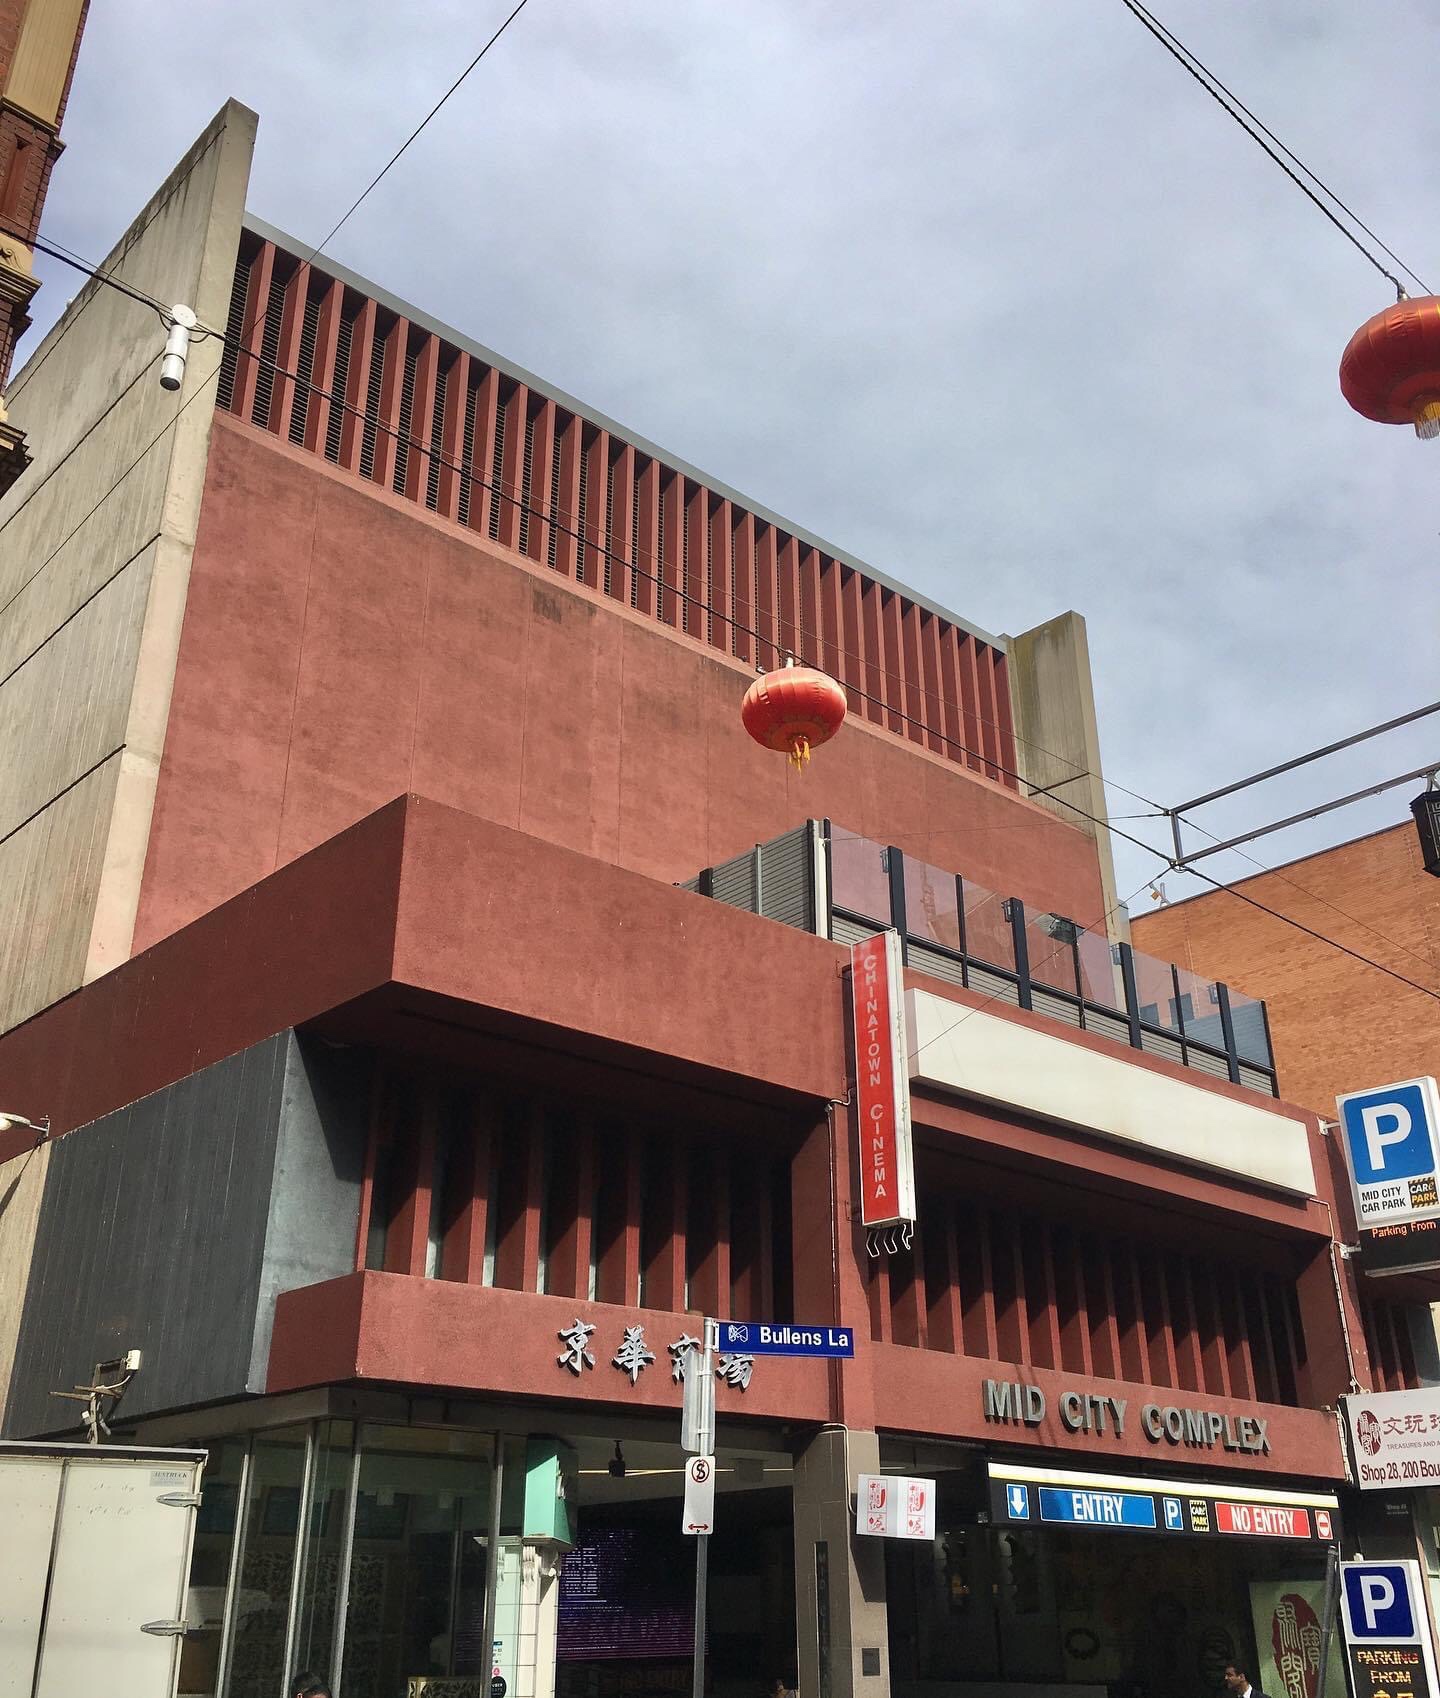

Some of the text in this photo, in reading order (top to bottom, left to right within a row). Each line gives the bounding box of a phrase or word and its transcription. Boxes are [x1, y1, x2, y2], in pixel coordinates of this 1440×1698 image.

[863, 954, 887, 1199] CHINATOWN CINEMA
[1361, 1102, 1412, 1171] P
[1361, 1186, 1401, 1202] MID CITY
[1411, 1191, 1437, 1203] PARK
[1361, 1197, 1407, 1214] CAR PARK
[1371, 1220, 1437, 1239] Parking From
[760, 1326, 849, 1347] Bullens La
[982, 1379, 1272, 1454] MID CITY COMPLEX
[1386, 1442, 1422, 1451] TREASURES
[1423, 1440, 1436, 1448] AND
[1360, 1463, 1386, 1484] Shop
[1401, 1460, 1419, 1479] 200
[1072, 1493, 1124, 1523] ENTRY
[1166, 1500, 1179, 1527] P
[1230, 1505, 1295, 1535] NO ENTRY
[1360, 1575, 1395, 1629] P
[1356, 1650, 1419, 1665] PARKING
[1370, 1670, 1412, 1684] FROM
